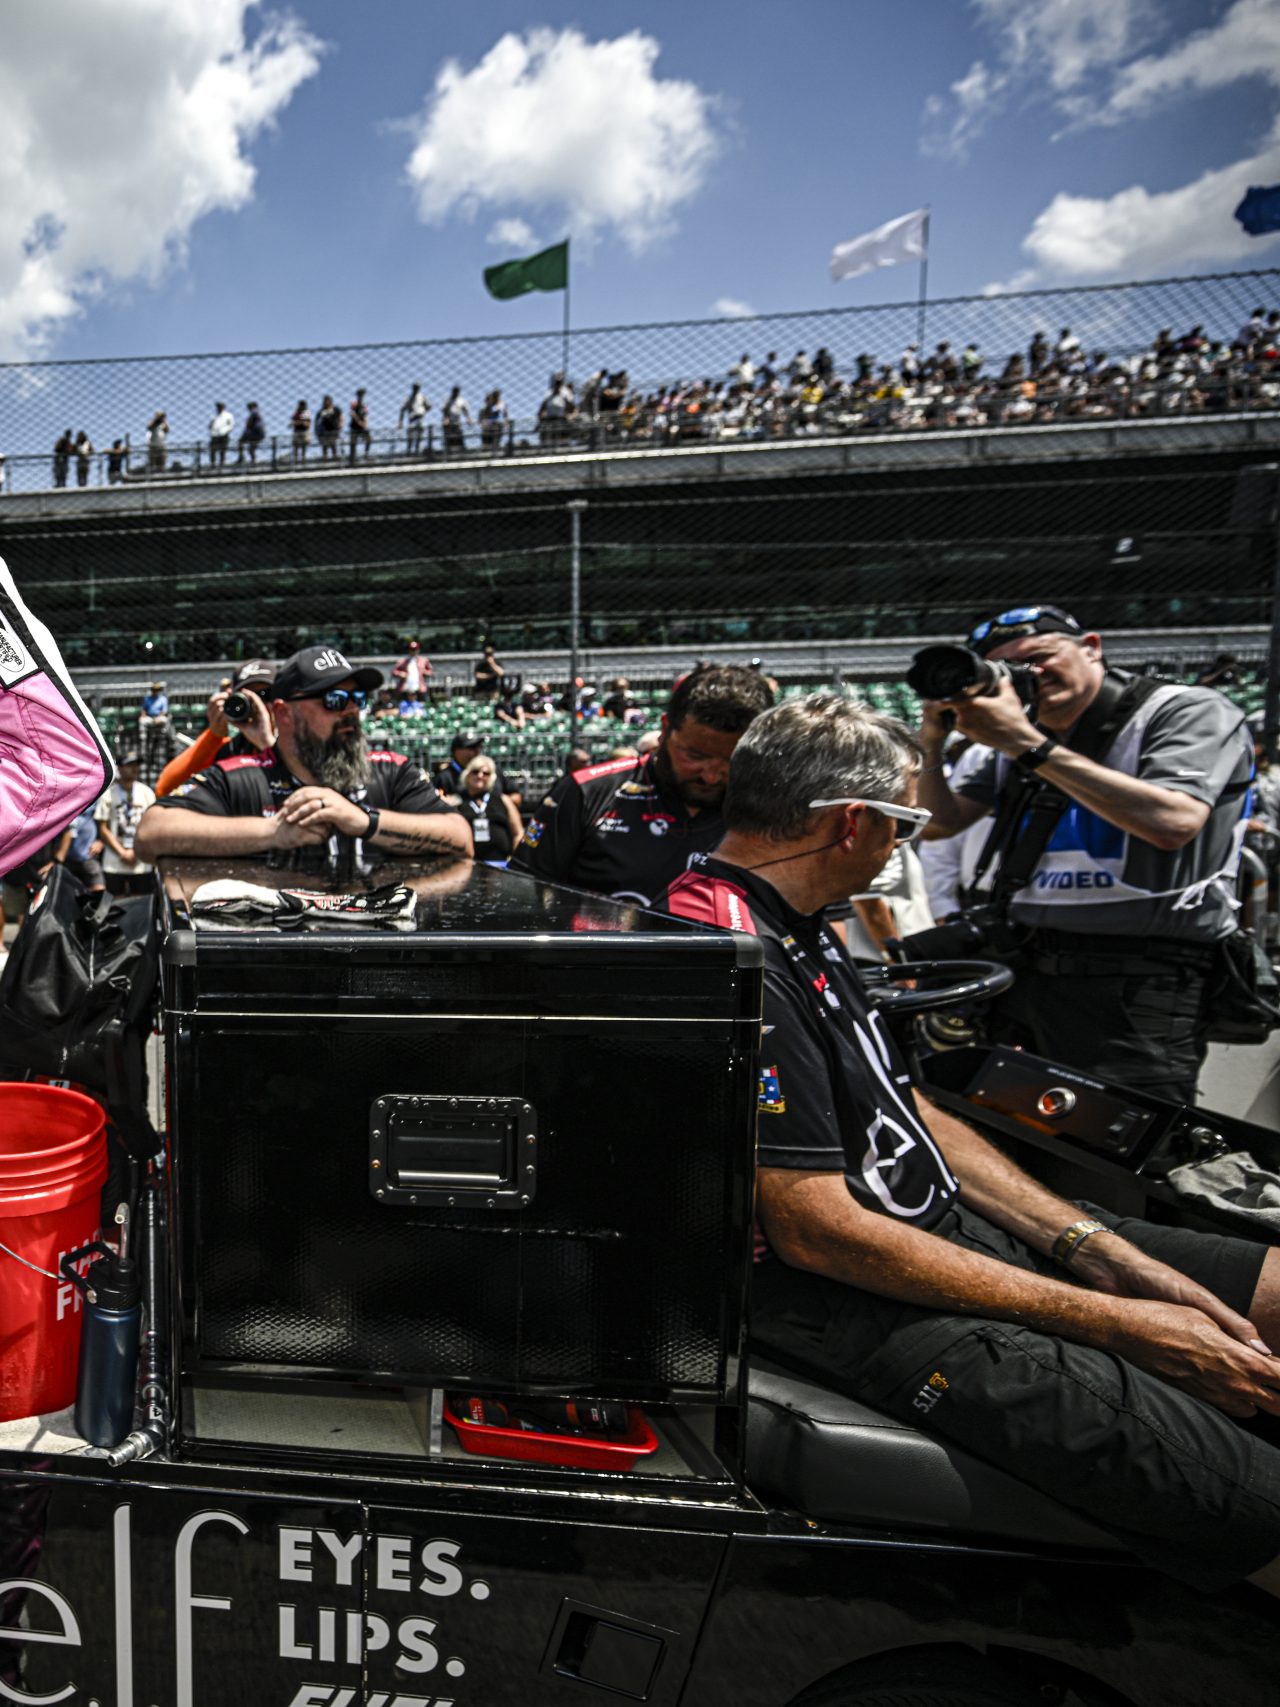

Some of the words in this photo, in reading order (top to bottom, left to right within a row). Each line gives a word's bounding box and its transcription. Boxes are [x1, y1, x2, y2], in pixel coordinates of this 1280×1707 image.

[1033, 870, 1115, 889] VIDEO
[913, 1384, 942, 1413] 5.11
[278, 1527, 491, 1600] EYES.
[278, 1605, 466, 1677] LIPS.
